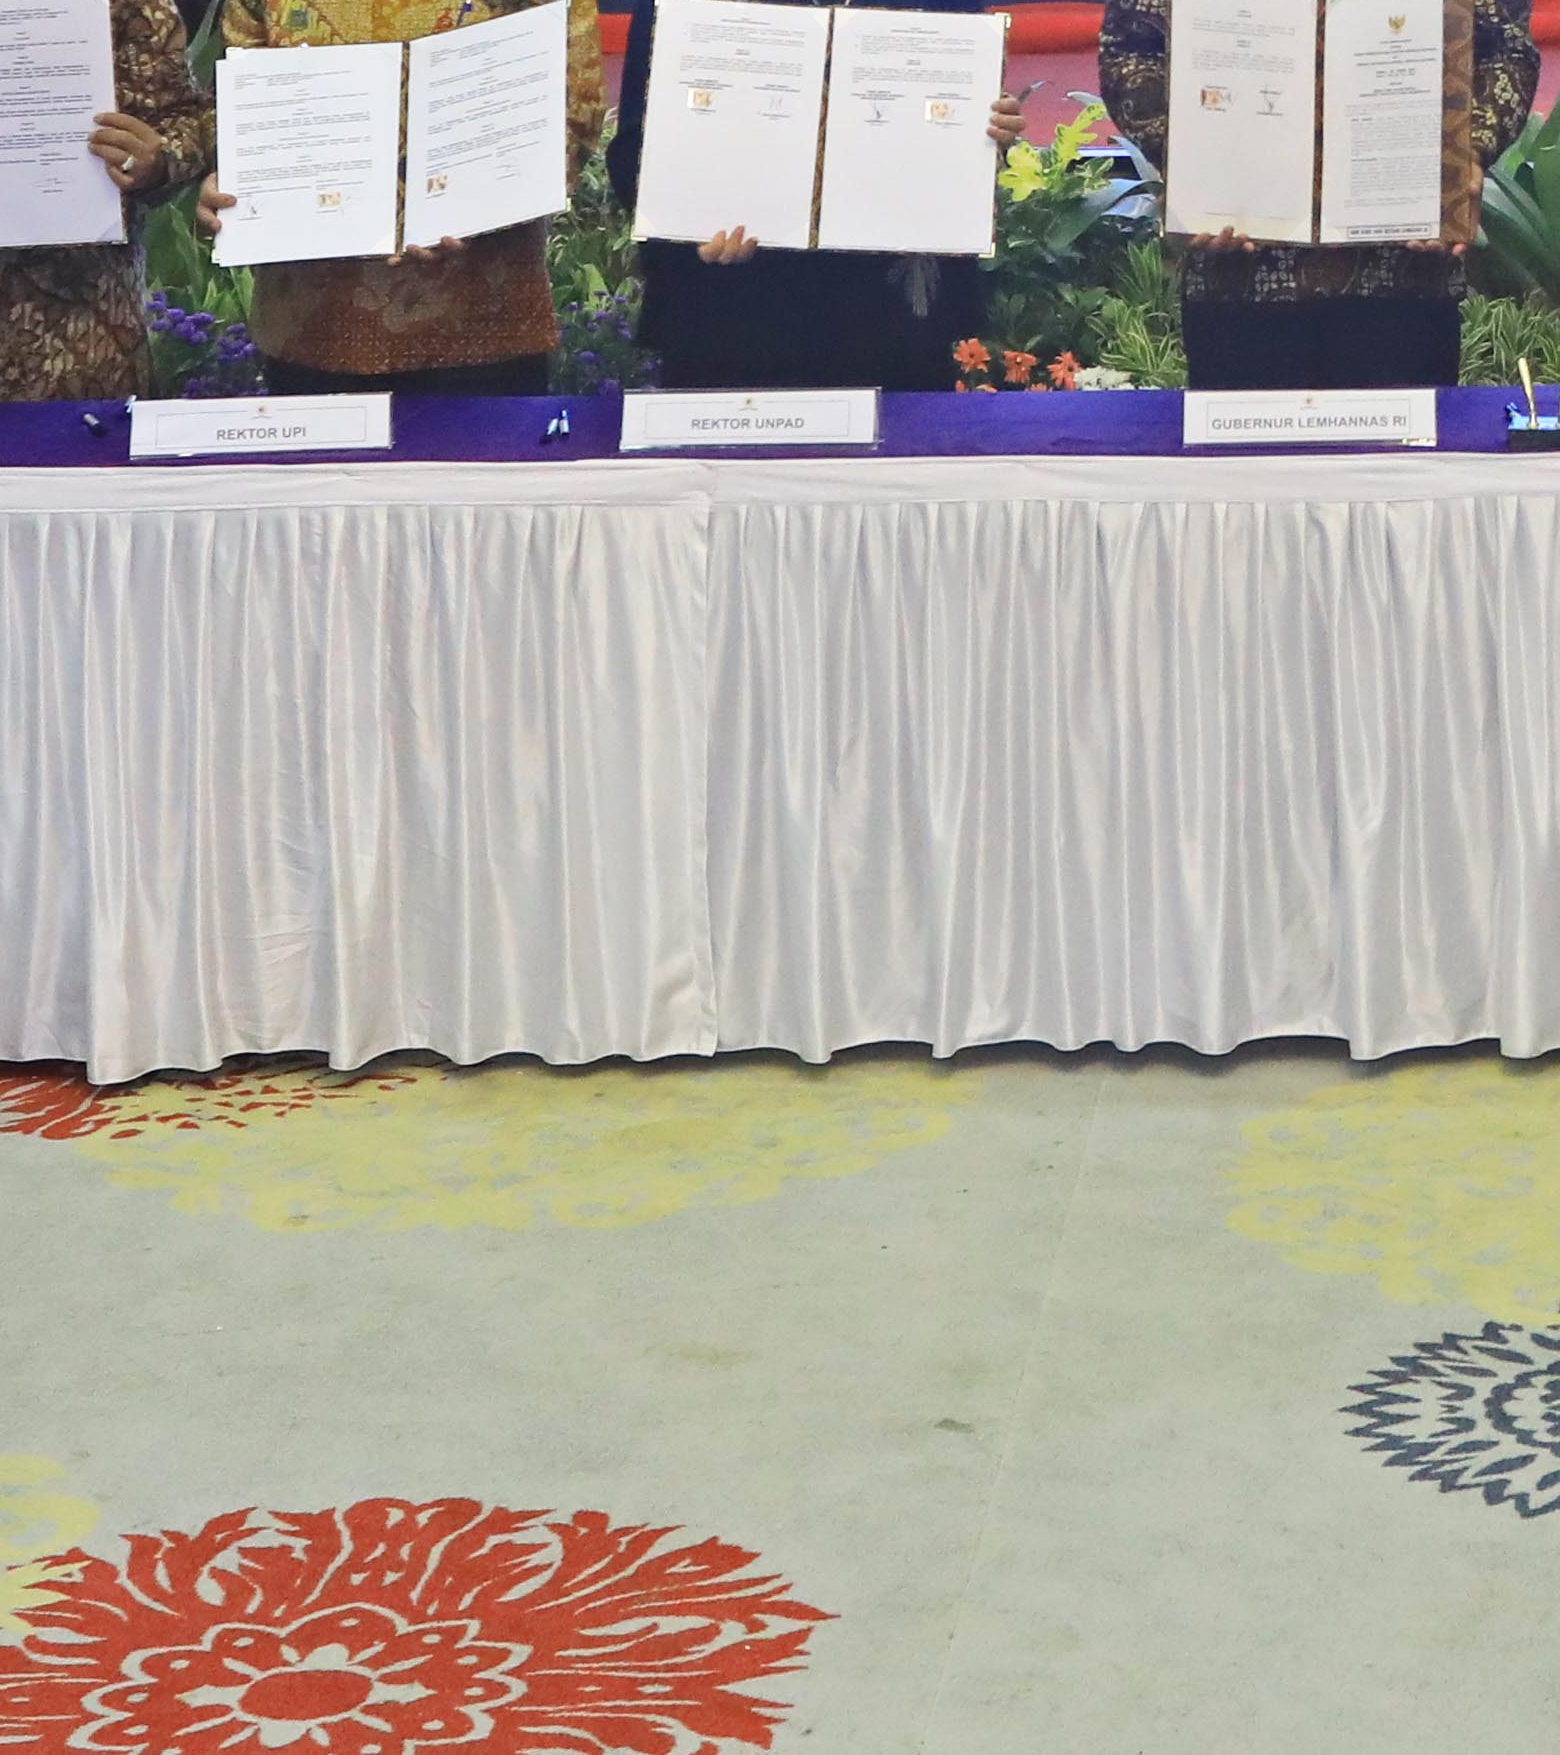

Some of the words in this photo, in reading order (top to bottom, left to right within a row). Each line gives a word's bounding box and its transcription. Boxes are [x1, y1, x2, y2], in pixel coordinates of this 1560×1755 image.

[691, 418, 750, 430] REKTOR
[755, 417, 805, 429] UNPAD
[1212, 417, 1293, 430] GUBERNUR
[1298, 416, 1388, 429] LEMHANNAS
[1393, 415, 1407, 426] RI
[216, 428, 278, 441] REKTOR
[282, 426, 307, 438] UPI
